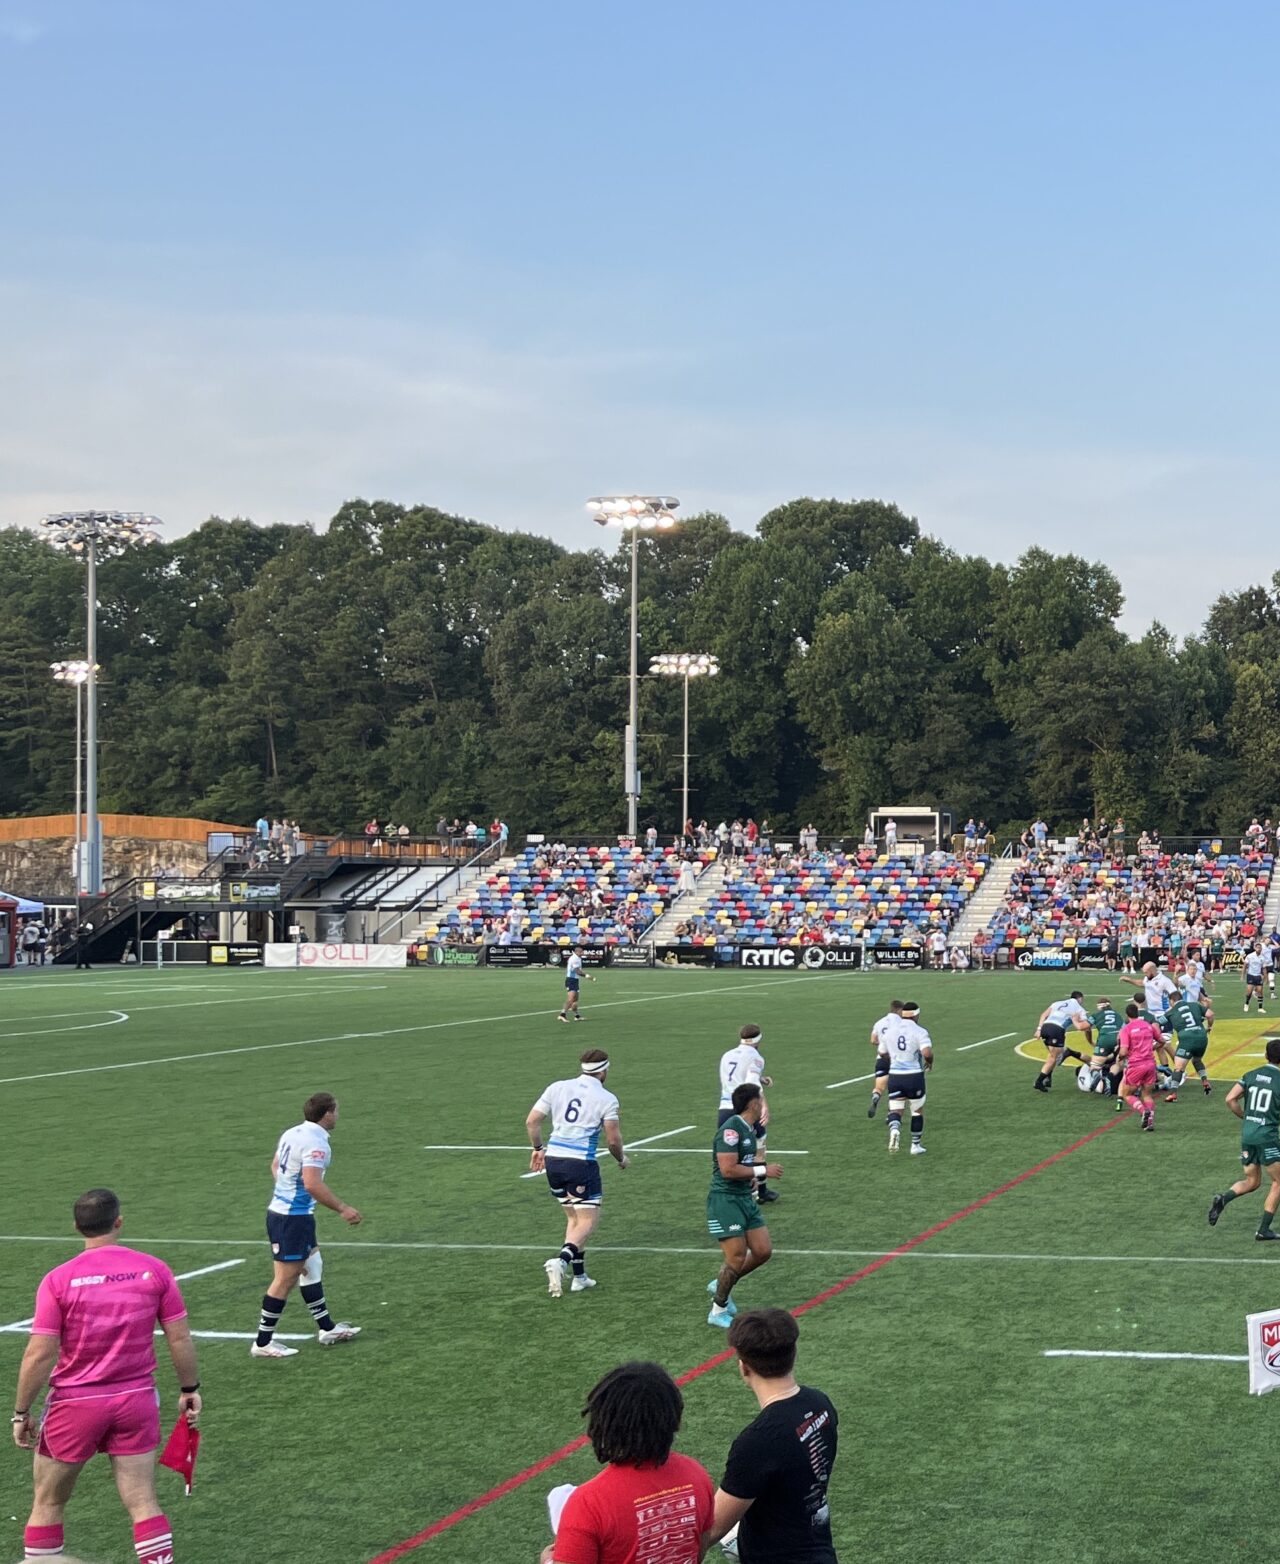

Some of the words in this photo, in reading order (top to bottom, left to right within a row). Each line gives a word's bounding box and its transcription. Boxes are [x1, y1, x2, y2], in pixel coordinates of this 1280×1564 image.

[323, 944, 368, 960] OLLI
[742, 948, 795, 966] RTIC
[827, 951, 854, 962] OLLI
[1033, 952, 1073, 960] RHINO
[1033, 959, 1071, 967] RUGBY
[1104, 1014, 1116, 1025] 5
[1181, 1012, 1197, 1028] 3
[897, 1034, 907, 1051] 8
[728, 1061, 737, 1081] 7
[1248, 1085, 1273, 1113] 10
[564, 1098, 583, 1124] 6
[278, 1142, 291, 1175] 14
